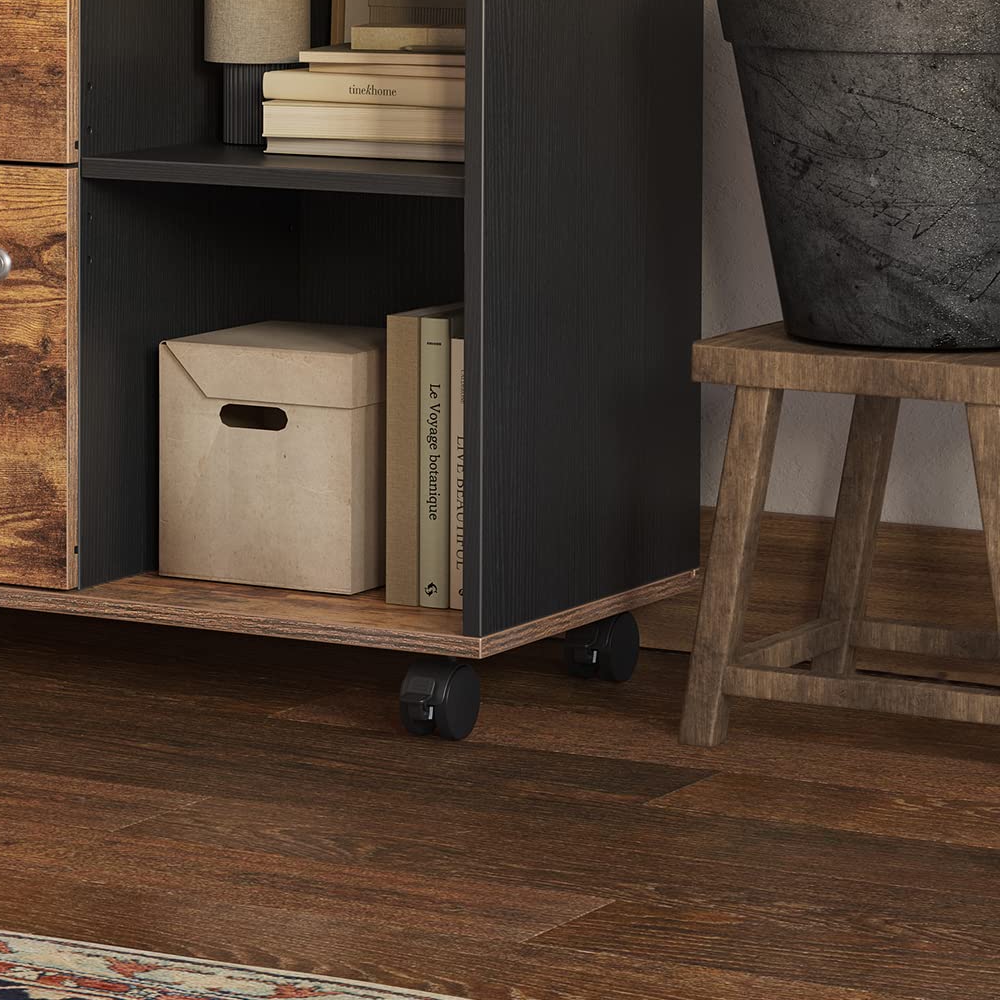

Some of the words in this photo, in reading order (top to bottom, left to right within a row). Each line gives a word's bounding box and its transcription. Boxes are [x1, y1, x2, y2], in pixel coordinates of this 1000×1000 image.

[348, 84, 397, 97] tinekhome
[429, 383, 441, 399] Le
[426, 403, 441, 450] Voyage
[426, 454, 441, 521] botanique
